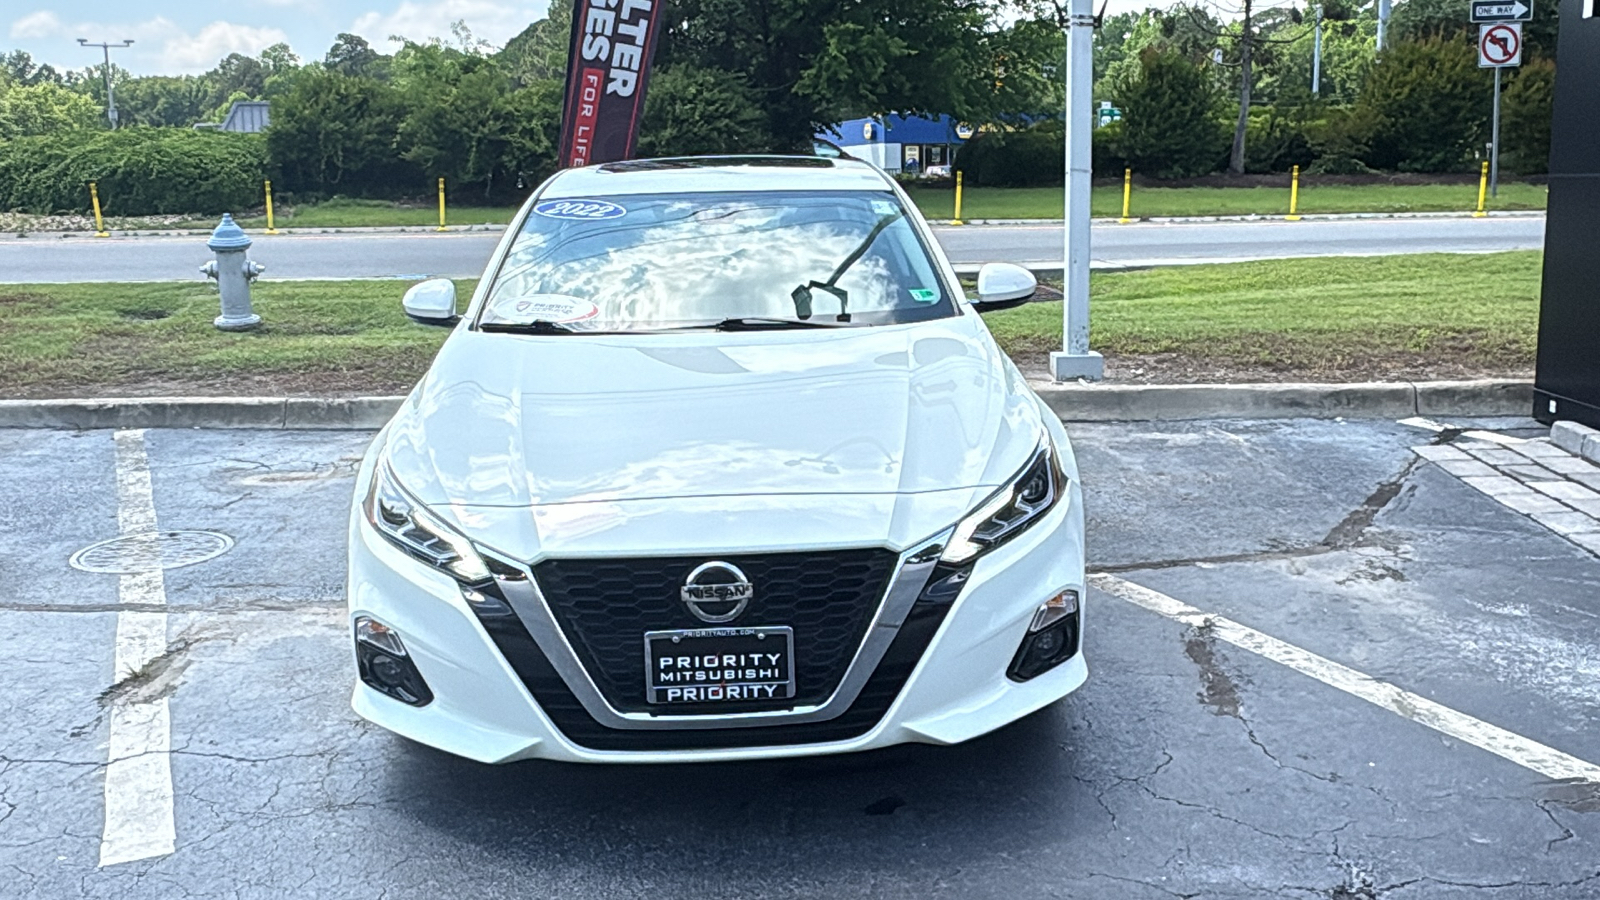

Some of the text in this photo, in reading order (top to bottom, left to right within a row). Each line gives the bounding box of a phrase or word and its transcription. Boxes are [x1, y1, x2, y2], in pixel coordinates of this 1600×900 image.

[1477, 6, 1514, 15] ONE WAY
[573, 75, 598, 167] FOR LIFE
[544, 202, 615, 217] 2022
[687, 585, 746, 600] NISSAN
[682, 629, 756, 638] PRIORITYAUTO.COM
[659, 653, 781, 669] PRIORITY
[659, 668, 780, 682] MITSUBISHI
[667, 684, 778, 702] PRIORITY
